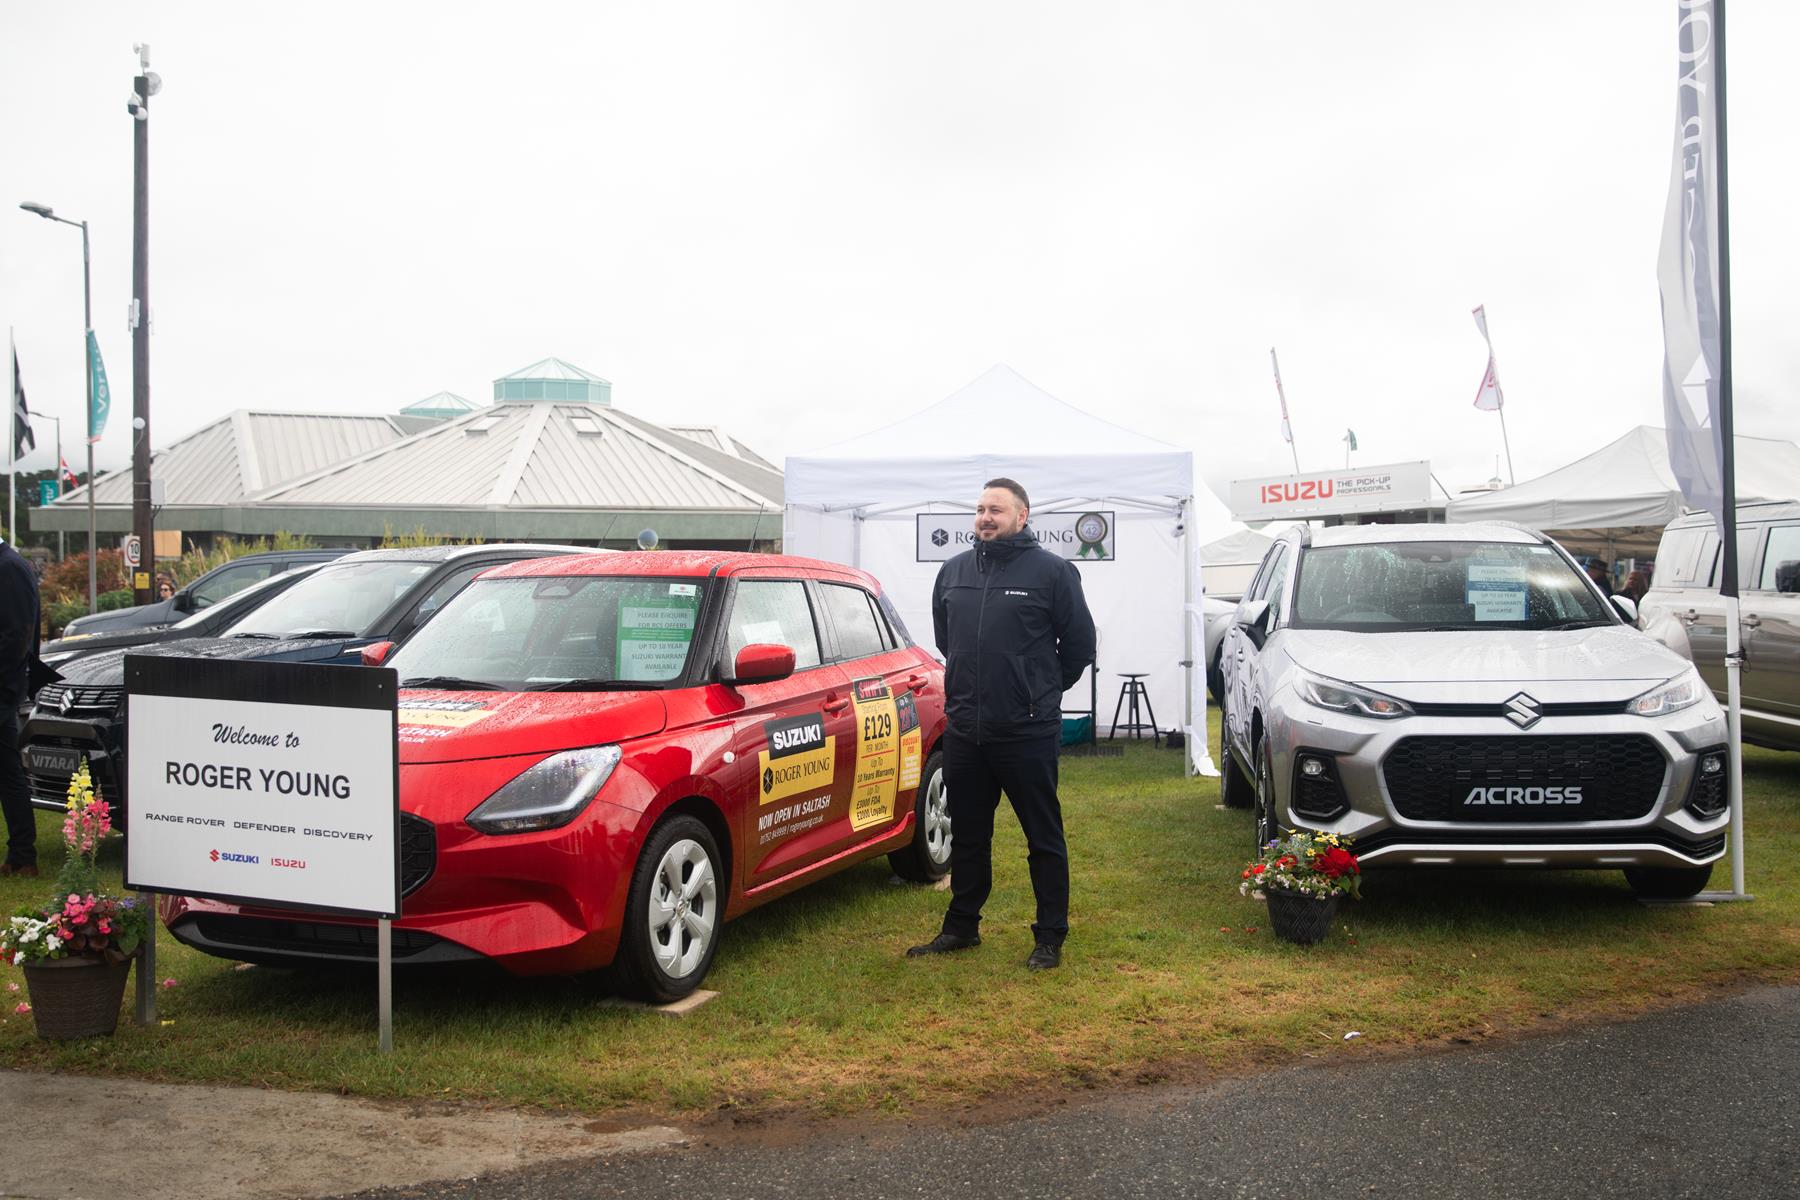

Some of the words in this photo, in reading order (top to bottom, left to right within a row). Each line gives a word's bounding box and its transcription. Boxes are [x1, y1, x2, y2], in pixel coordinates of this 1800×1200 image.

[1261, 480, 1333, 504] ISUZU
[1337, 480, 1353, 488] THE
[1356, 476, 1391, 486] PICK-UP
[1336, 485, 1391, 495] PROFESSIONALS
[212, 723, 279, 748] Welcome
[285, 731, 301, 748] to
[772, 723, 821, 750] SUZUKI
[864, 712, 892, 742] £129
[31, 754, 76, 771] VITARA
[774, 764, 802, 785] ROGER
[803, 757, 830, 777] YOUNG
[863, 771, 875, 781] Years
[875, 768, 896, 778] Warranty
[165, 761, 253, 792] ROGER
[258, 768, 351, 800] YOUNG
[1463, 786, 1584, 806] ACROSS
[758, 811, 774, 832] NOW
[774, 806, 793, 825] OPEN
[792, 803, 802, 818] IN
[801, 794, 832, 816] SALTASH
[870, 804, 888, 817] Loyalty
[145, 812, 184, 824] RANGE
[186, 816, 226, 828] ROVER
[233, 821, 296, 834] DEFENDER
[302, 828, 374, 842] DISCOVERY
[221, 852, 260, 865] SUZUKI
[271, 857, 306, 869] ISUZU
